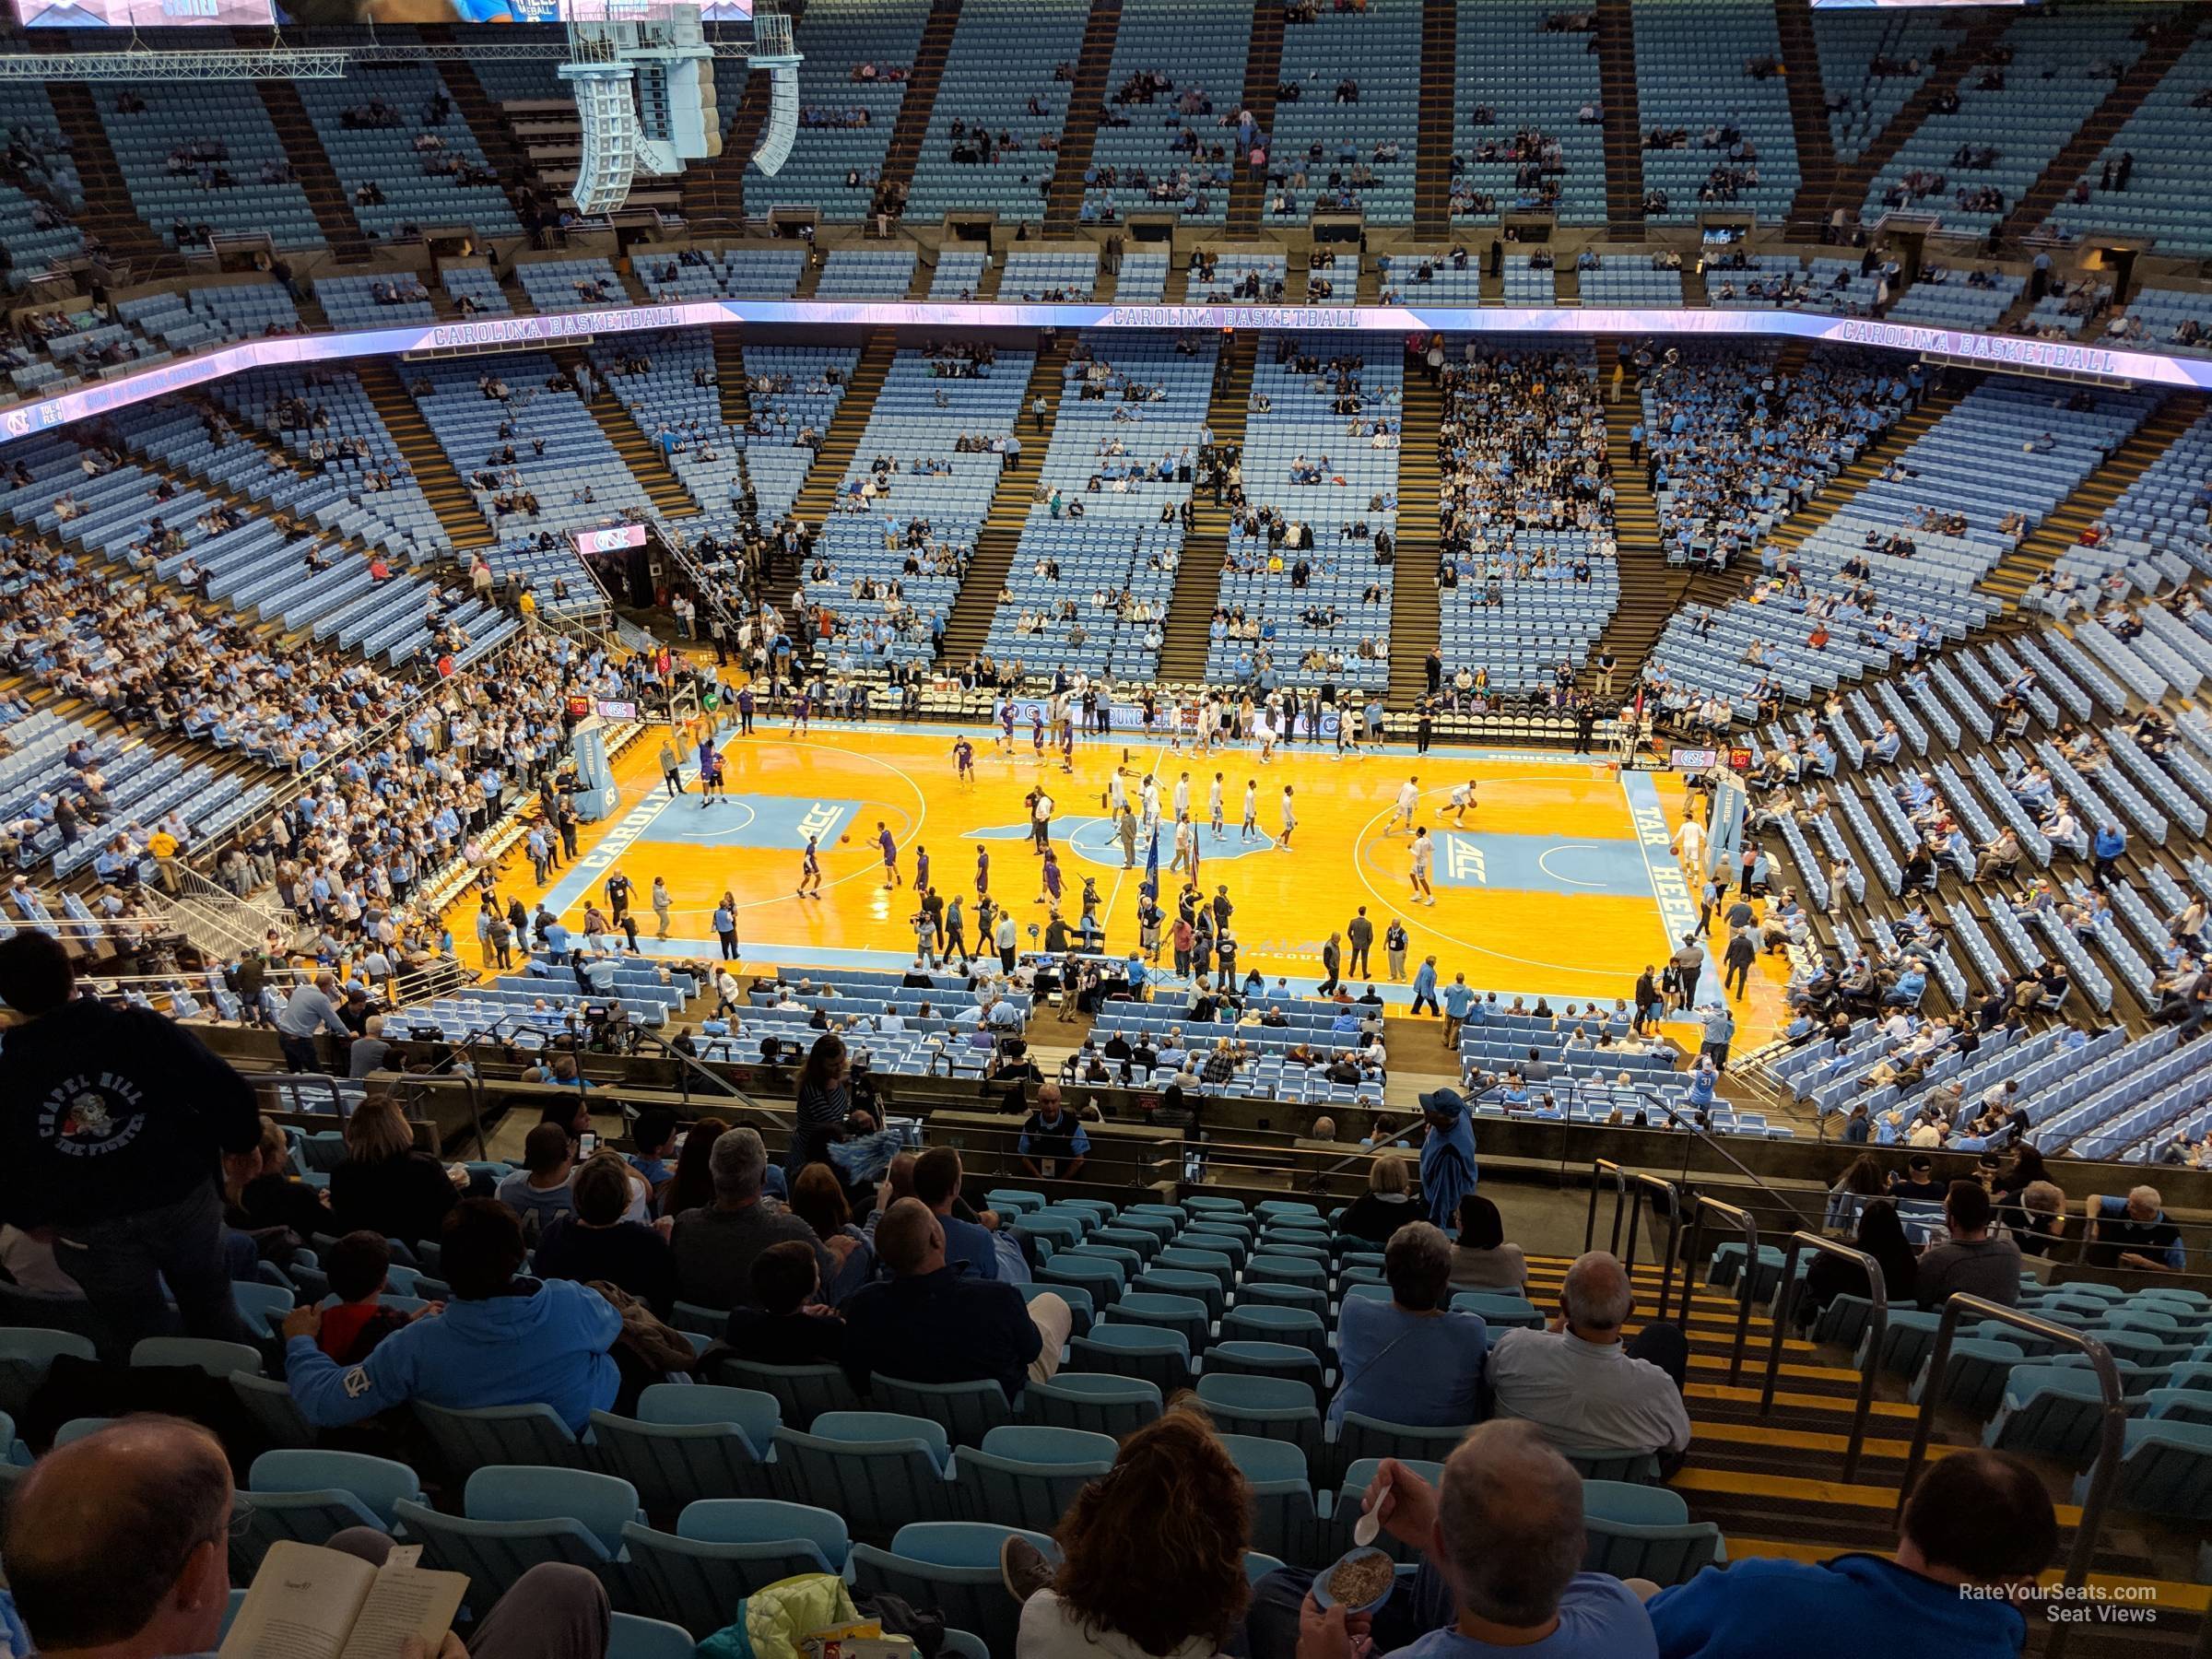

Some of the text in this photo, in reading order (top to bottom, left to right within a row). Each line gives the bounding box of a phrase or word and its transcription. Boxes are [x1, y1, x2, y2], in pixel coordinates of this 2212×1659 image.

[433, 307, 679, 346] CAROLINA BASKETBALL
[1113, 308, 1359, 327] CAROLINA BASKETBALL
[1843, 320, 2115, 373] CAROLINA BASKETBALL
[1735, 756, 1746, 765] 30
[796, 802, 839, 844] ACC
[1635, 806, 1670, 846] TAR
[1454, 837, 1486, 884] ACC
[1652, 865, 1705, 944] HEELS
[1700, 1077, 1712, 1087] 31
[39, 1071, 143, 1137] CHAPEL HILL
